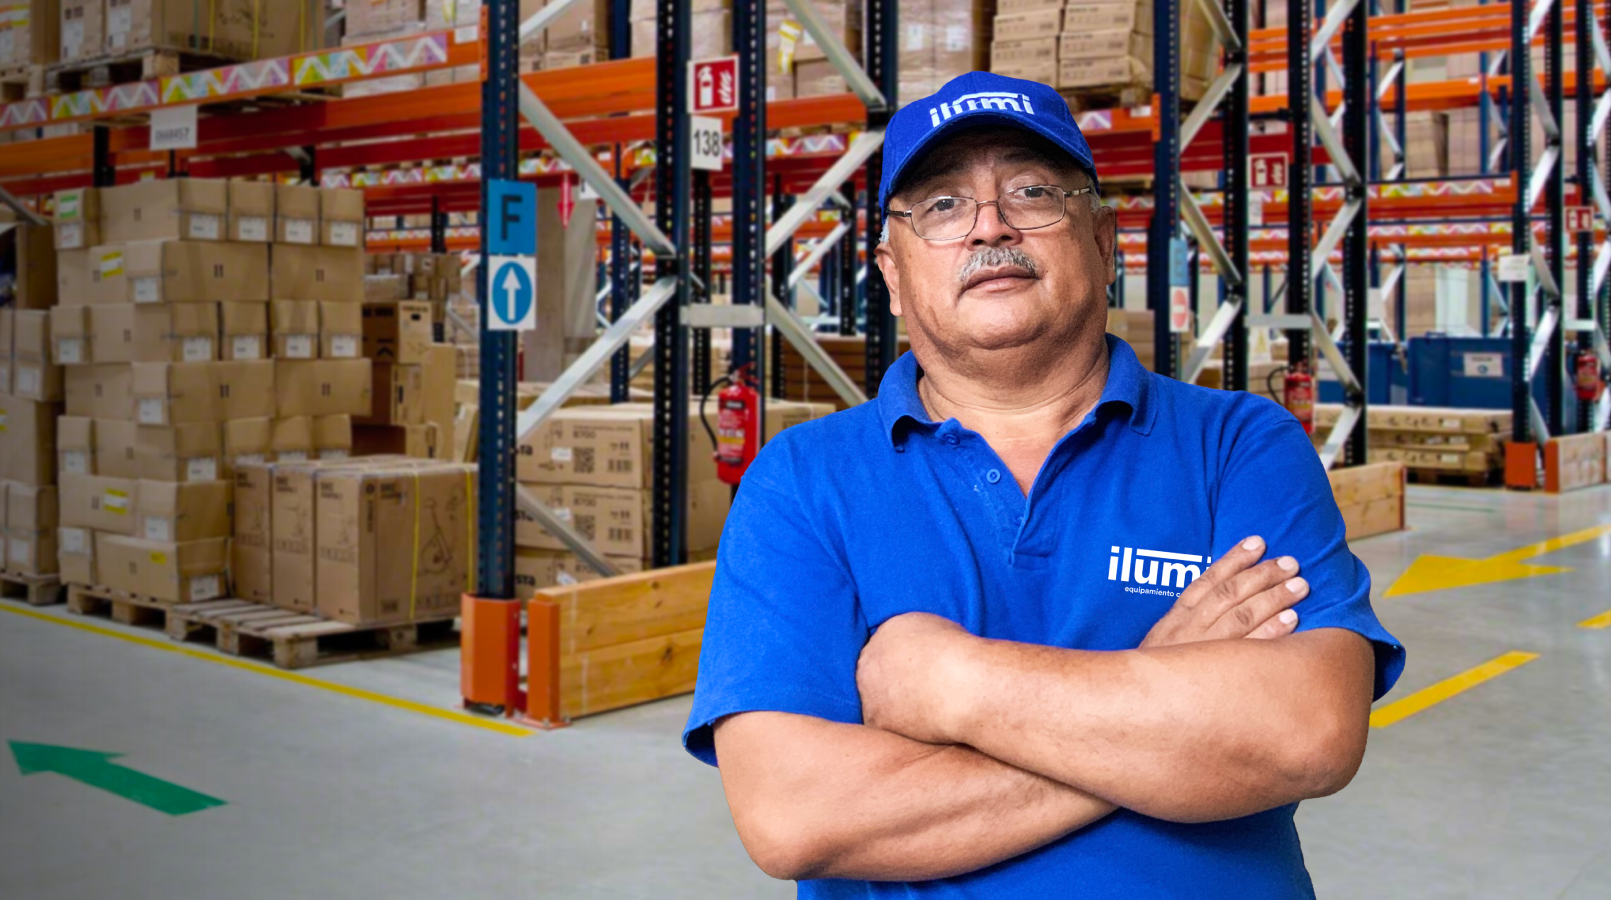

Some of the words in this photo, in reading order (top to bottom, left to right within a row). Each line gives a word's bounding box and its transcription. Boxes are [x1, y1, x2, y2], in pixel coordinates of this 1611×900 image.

[930, 91, 1035, 128] ilumi
[694, 129, 720, 157] 138
[502, 194, 522, 241] F
[1107, 545, 1212, 589] ilum
[1124, 586, 1175, 598] equipamiento
